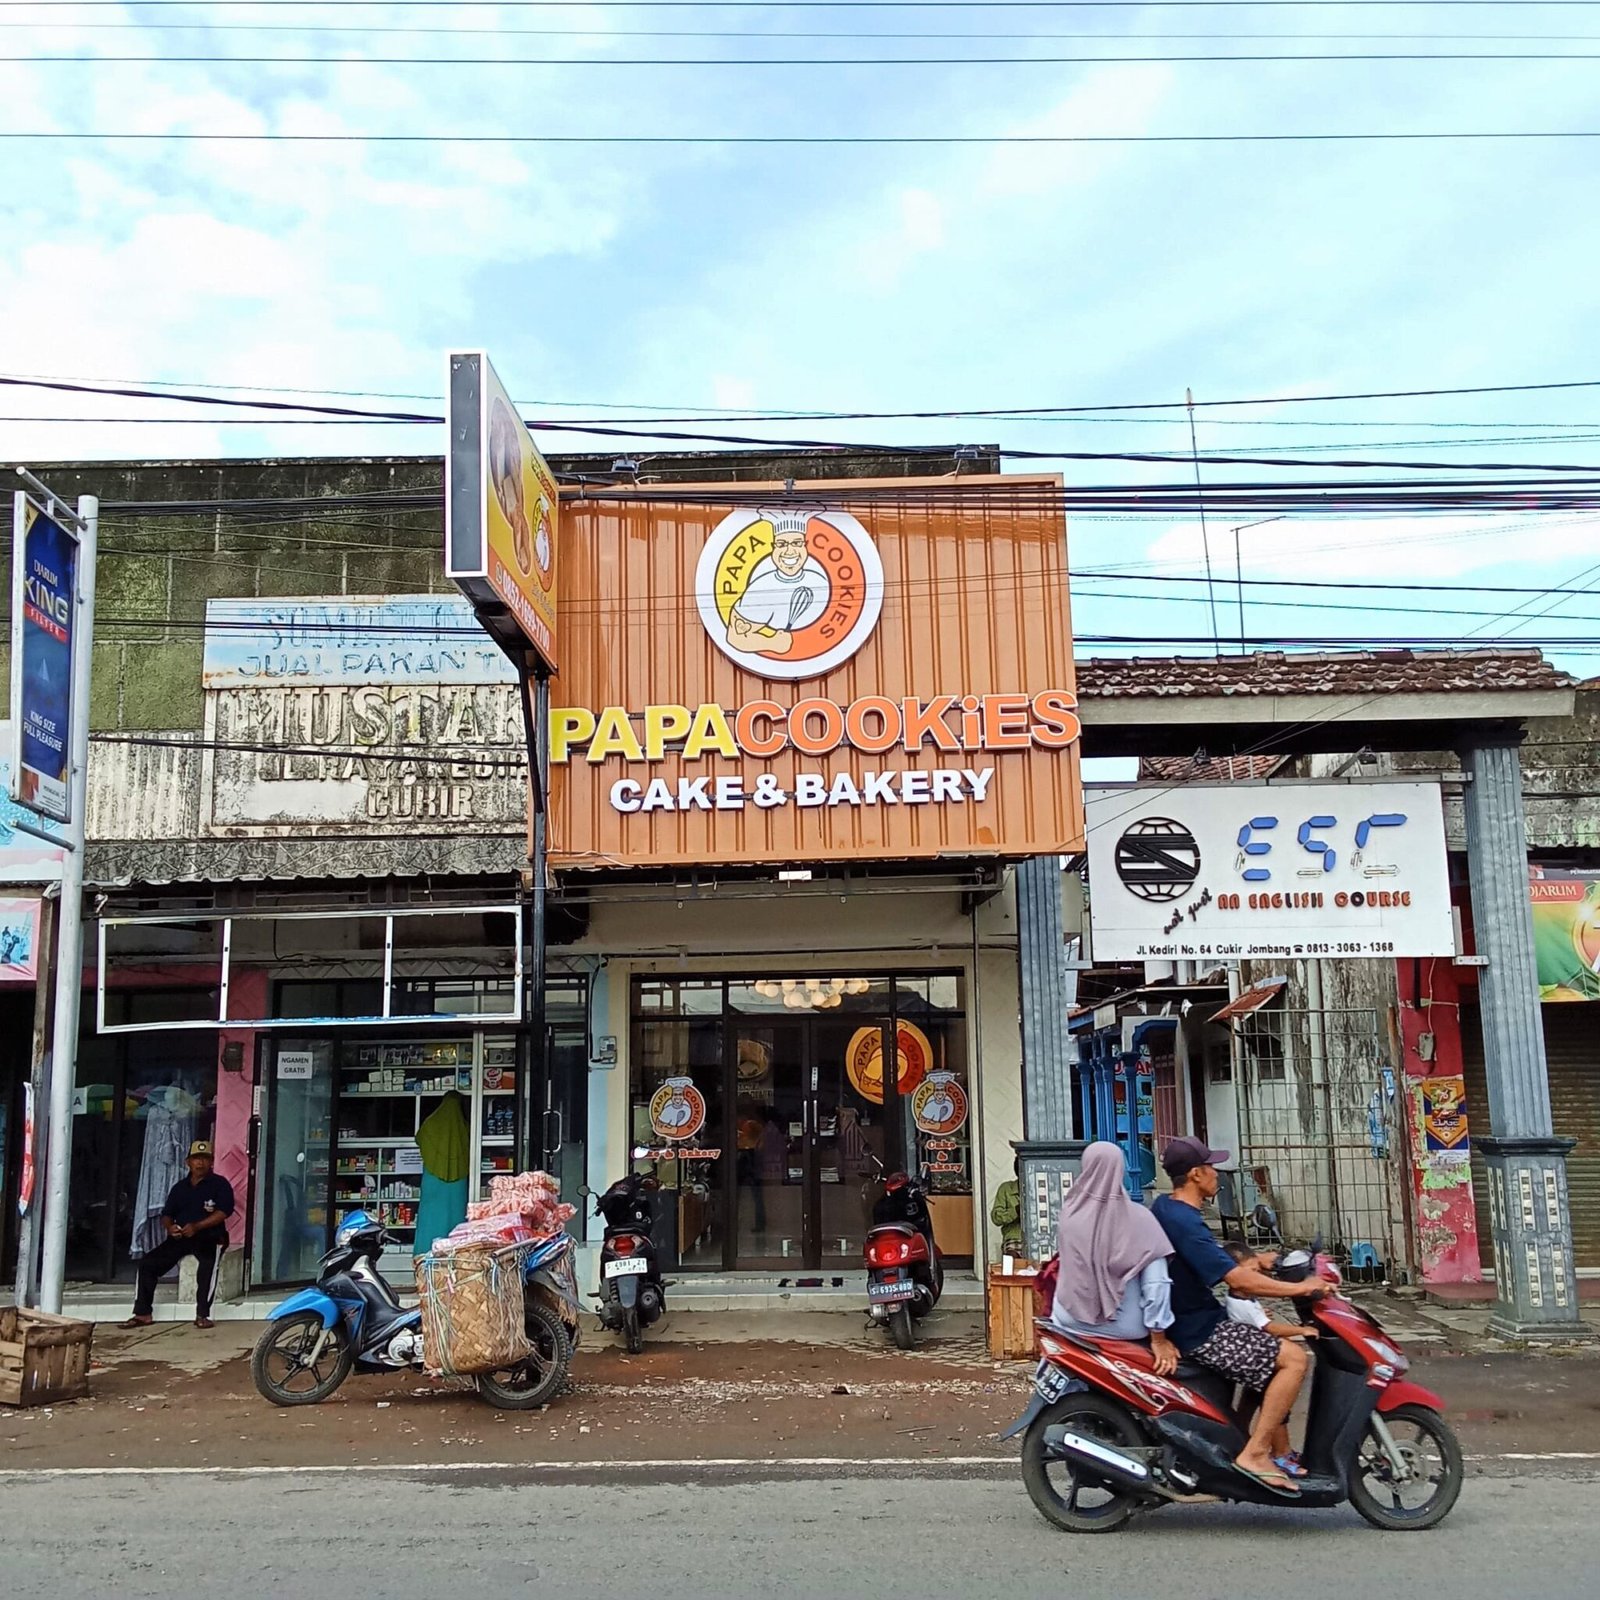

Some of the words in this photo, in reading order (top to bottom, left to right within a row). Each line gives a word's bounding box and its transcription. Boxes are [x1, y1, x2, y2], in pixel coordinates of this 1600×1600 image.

[722, 535, 766, 595] PAPA
[812, 533, 856, 639] COOKIES
[30, 710, 43, 726] KING
[43, 718, 56, 733] SIZE
[23, 721, 36, 738] FULL
[35, 730, 63, 752] PLEASURE
[610, 776, 744, 812] CAKE
[753, 774, 787, 808] &
[796, 768, 995, 807] BAKERY
[1334, 890, 1411, 908] COURSE
[1149, 944, 1178, 955] Kediri
[1181, 944, 1198, 955] No.
[1199, 944, 1212, 954] 64
[1216, 943, 1243, 955] Cukir
[1247, 943, 1290, 956] Jombang
[281, 1056, 309, 1064] NGAMEN
[283, 1066, 306, 1074] GRATIS
